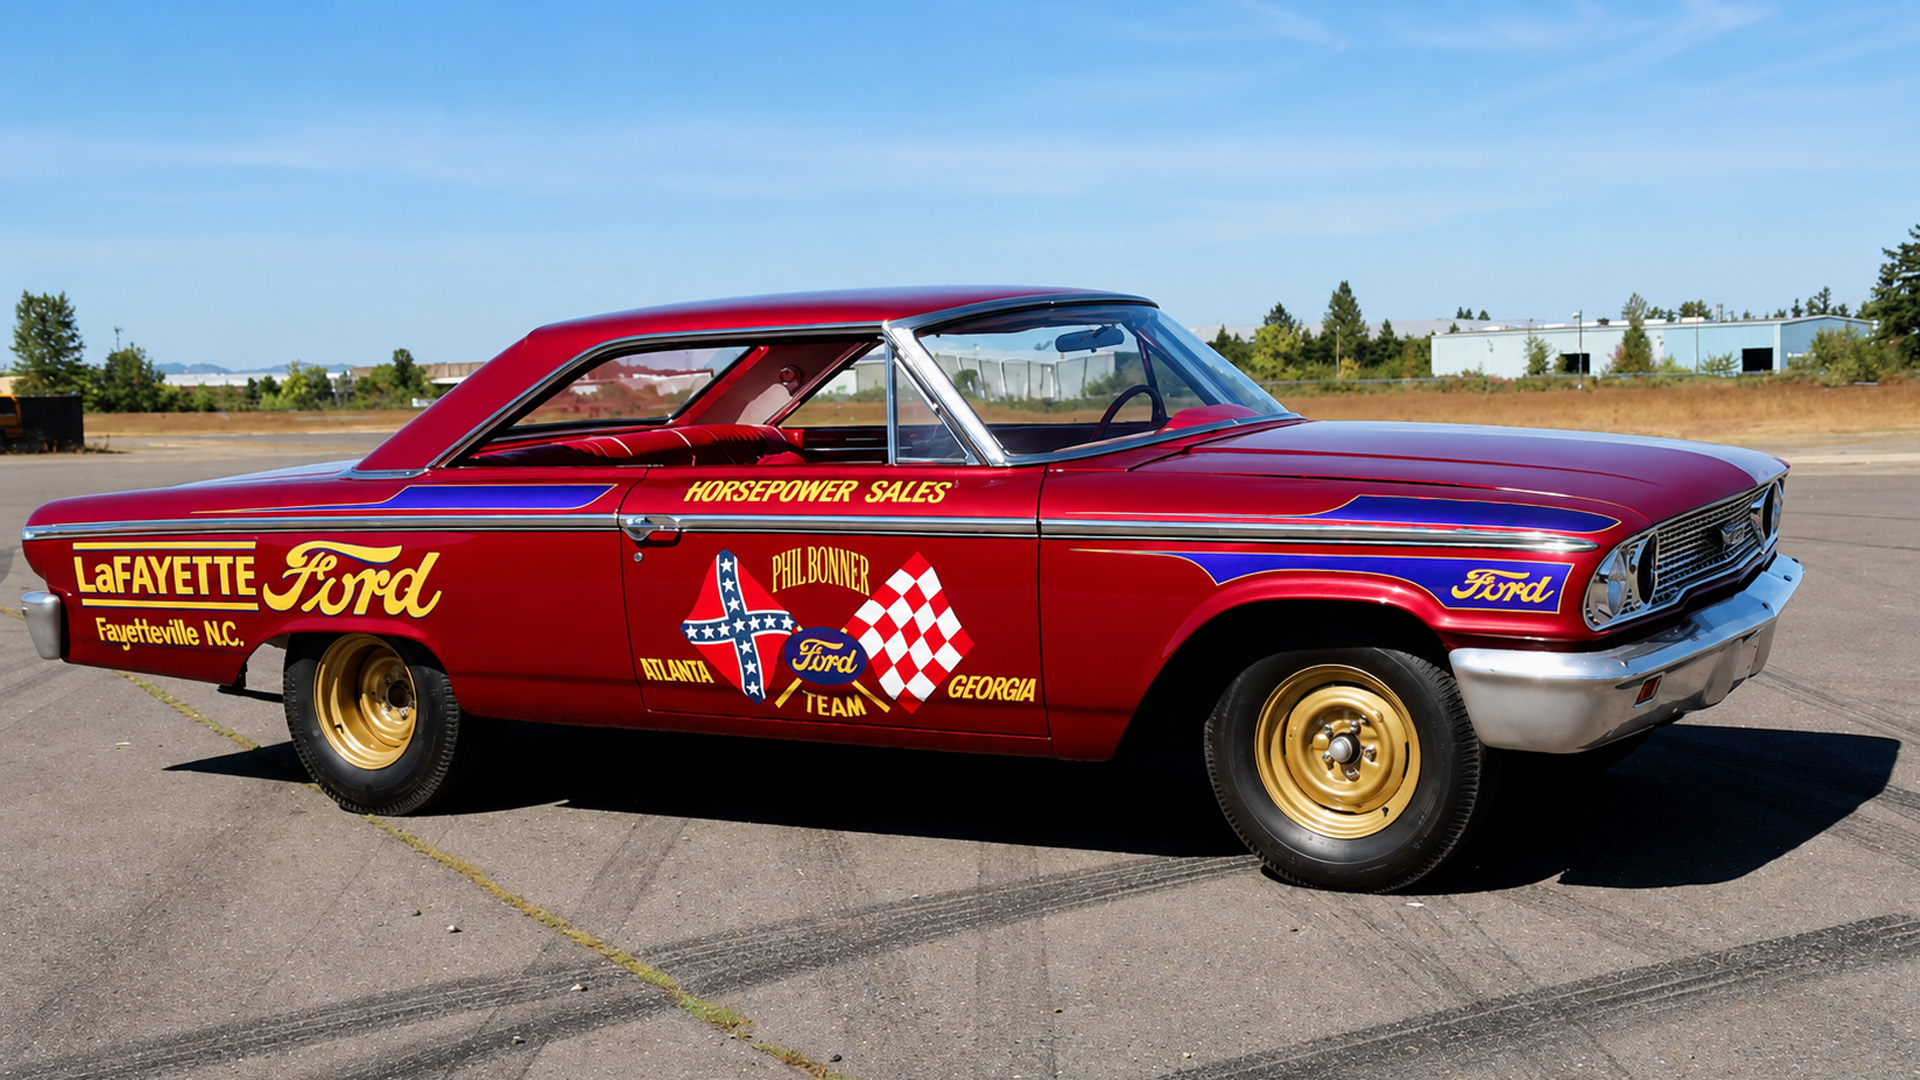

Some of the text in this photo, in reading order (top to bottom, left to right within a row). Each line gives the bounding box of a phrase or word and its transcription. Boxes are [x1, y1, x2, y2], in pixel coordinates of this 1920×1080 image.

[684, 480, 952, 503] HORSEPOWER SALES
[74, 541, 442, 618] LaFAYETTE Ford
[772, 546, 870, 596] PHIL BONNER
[1451, 568, 1554, 603] Ford
[96, 618, 245, 651] Fayetteville N.C.
[640, 657, 714, 684] ATLANTA
[792, 639, 858, 674] Ford
[802, 690, 867, 717] TEAM
[948, 675, 1037, 702] GEORGIA
